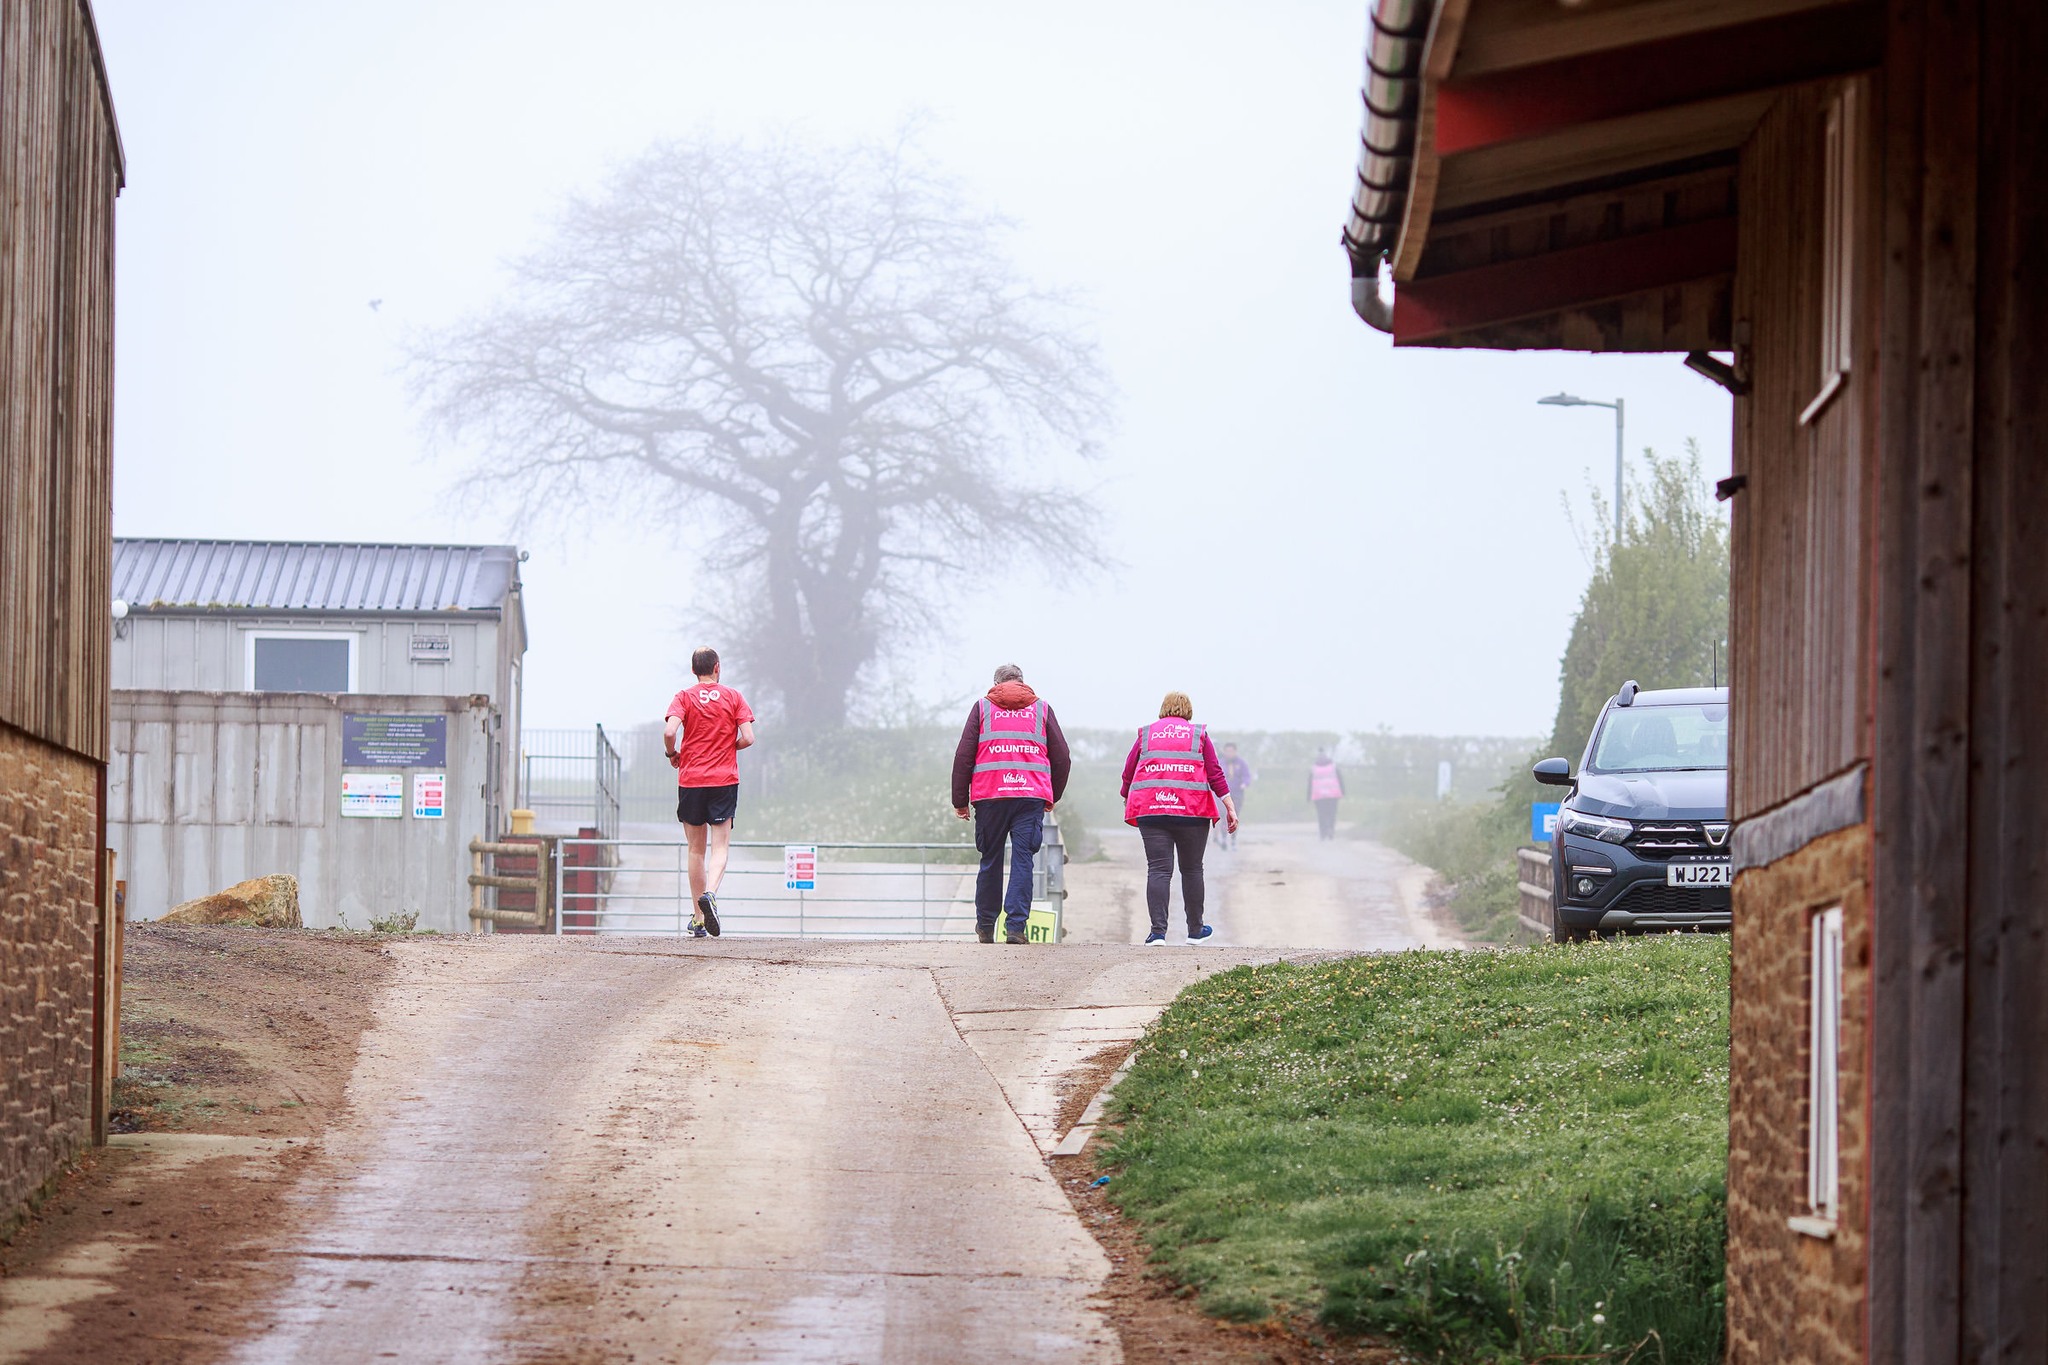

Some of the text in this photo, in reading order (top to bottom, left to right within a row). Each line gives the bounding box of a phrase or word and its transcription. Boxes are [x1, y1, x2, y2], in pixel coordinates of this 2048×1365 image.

[699, 689, 721, 704] 50
[994, 709, 1034, 720] parkrun
[1151, 728, 1190, 740] parkrun
[988, 744, 1040, 755] VOLUNTEER
[1144, 763, 1195, 773] VOLUNTEER
[1002, 772, 1027, 786] Vitality
[1155, 790, 1179, 804] Vitality
[1675, 866, 1721, 883] WJ22
